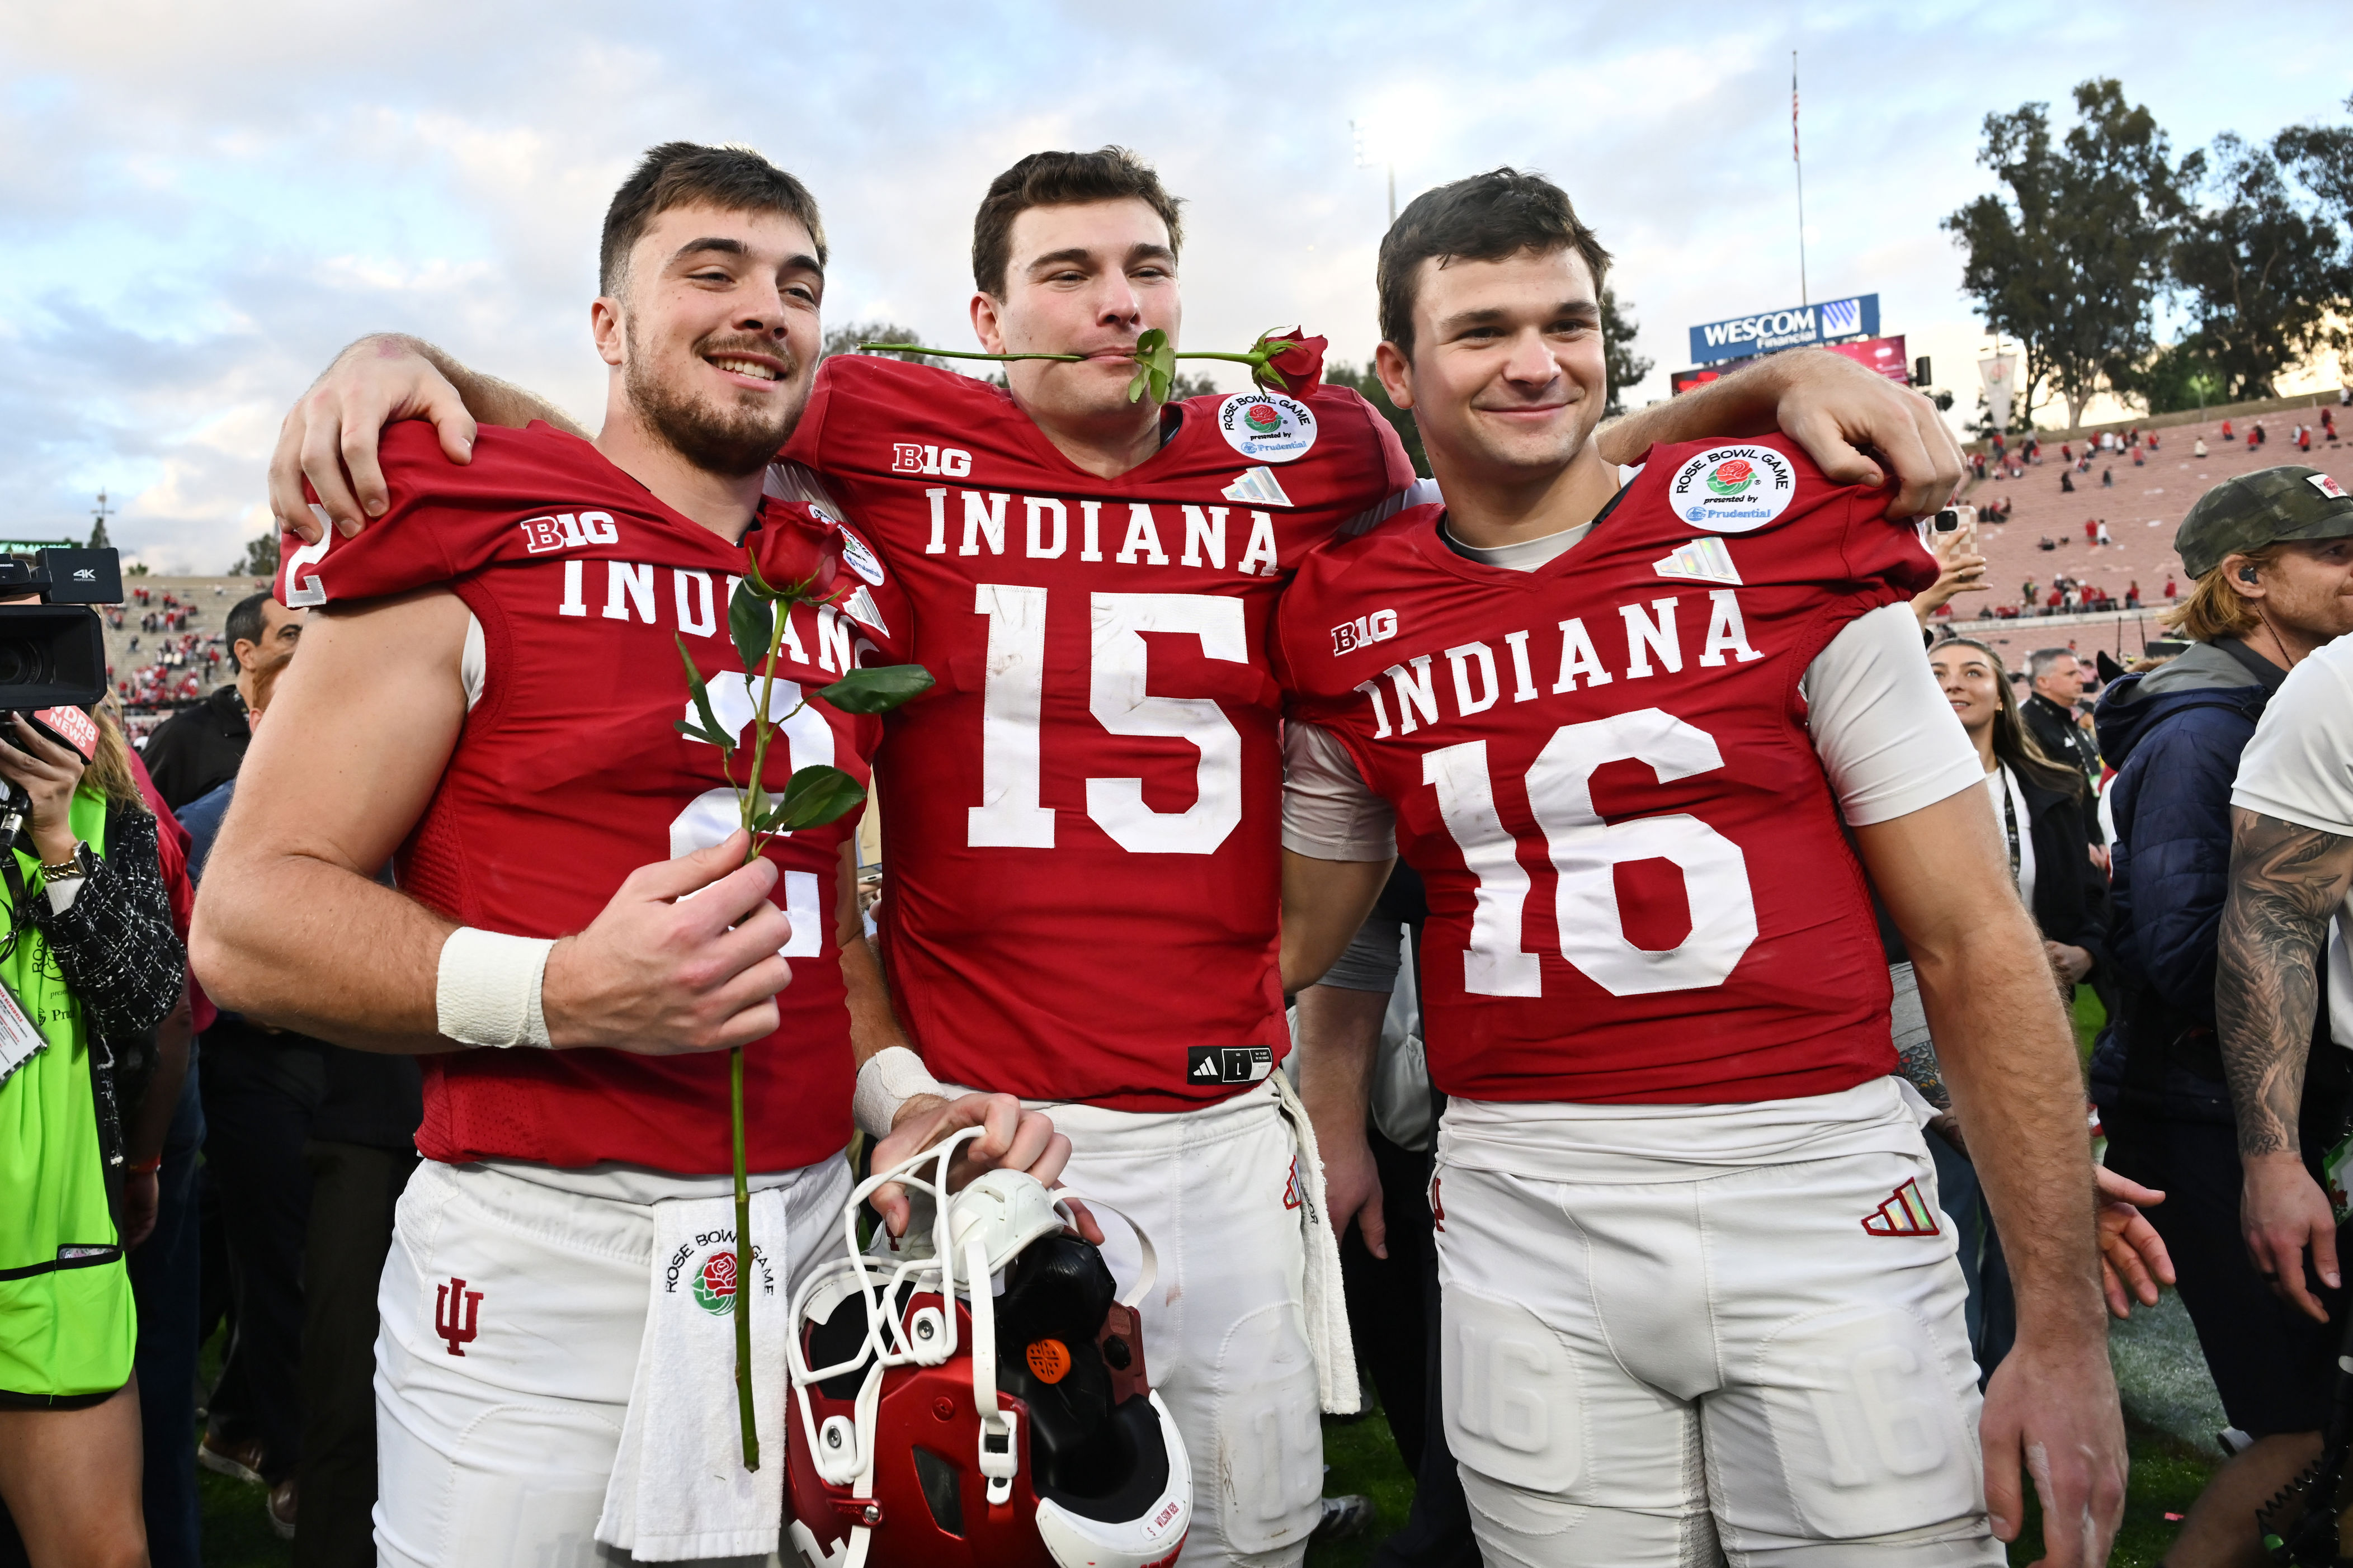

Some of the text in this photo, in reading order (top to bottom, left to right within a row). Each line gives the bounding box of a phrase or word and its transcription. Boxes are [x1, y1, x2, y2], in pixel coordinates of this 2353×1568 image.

[1704, 307, 1816, 347] WESCOM
[1757, 330, 1817, 350] Financial
[1223, 395, 1311, 431] ROSE BOWL GAME
[1250, 432, 1281, 441] presented
[1258, 441, 1307, 451] Prudential
[1676, 449, 1788, 494] ROSE BOWL GAME
[1704, 495, 1745, 504] presented
[1708, 508, 1772, 518] Prudential
[925, 487, 1279, 578] INDIANA
[73, 569, 96, 579] 4K
[285, 503, 328, 608] 2
[559, 560, 880, 677] INDAN
[1354, 589, 1765, 739] INDIANA
[49, 712, 87, 748] NEWS
[968, 583, 1249, 855] 15
[671, 670, 835, 957] 2
[1422, 707, 1759, 998] 16
[1237, 1062, 1242, 1075] L
[666, 1229, 774, 1296] ROSE BOW GAME
[1154, 1508, 1173, 1528] WILSON
[1167, 1501, 1179, 1515] 828
